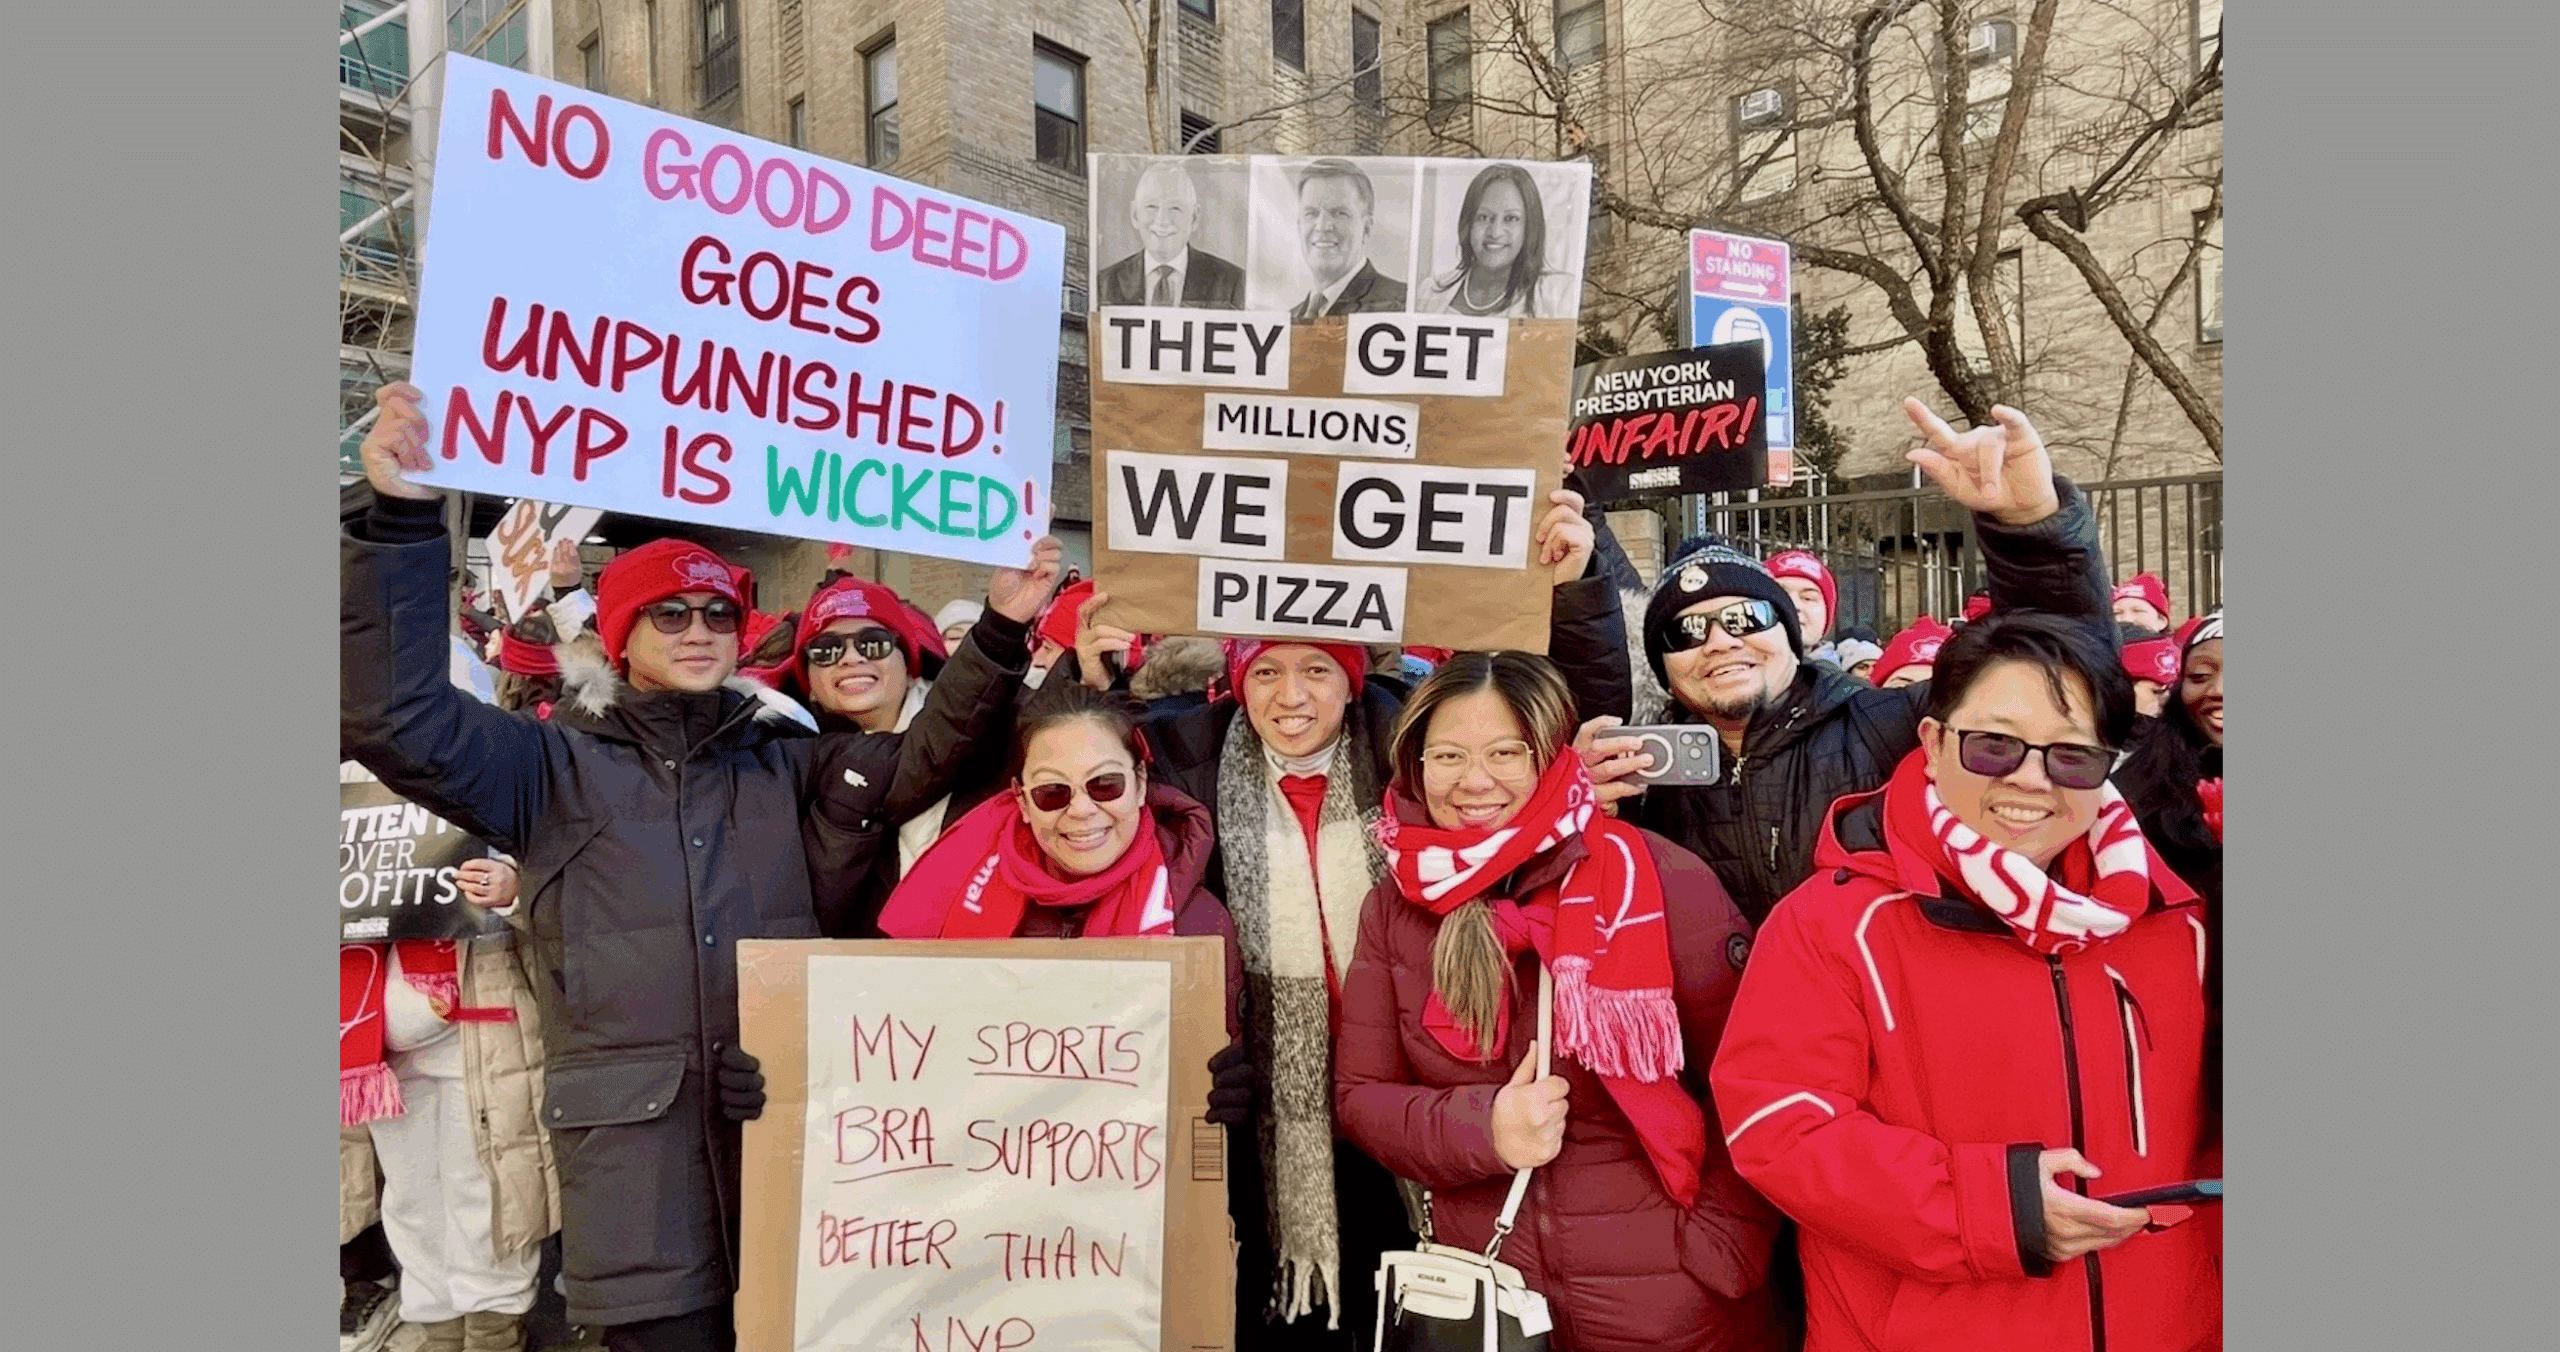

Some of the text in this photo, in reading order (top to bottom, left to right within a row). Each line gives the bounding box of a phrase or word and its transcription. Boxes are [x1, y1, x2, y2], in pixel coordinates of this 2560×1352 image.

[487, 89, 1028, 280] NO GOOD DEED
[1706, 256, 1775, 282] STANDING
[1728, 240, 1752, 260] NO
[680, 235, 880, 344] GOES
[482, 297, 1004, 457] UNPUNISHED!
[1110, 317, 1495, 381] THEY GET
[1594, 360, 1712, 393] NEW YORK
[1217, 402, 1411, 454] MILLIONS,
[1574, 379, 1735, 417] PRESBYTERIAN
[441, 387, 1035, 542] NYP IS WICKED!
[1121, 465, 1529, 557] WE GET
[1213, 570, 1393, 632] PIZZA
[852, 1013, 1144, 1082] MY SPORTS
[833, 1105, 1161, 1189] BRA SUPPORTS
[817, 1210, 1127, 1281] BETTER THAN
[911, 1312, 1035, 1352] NYP
